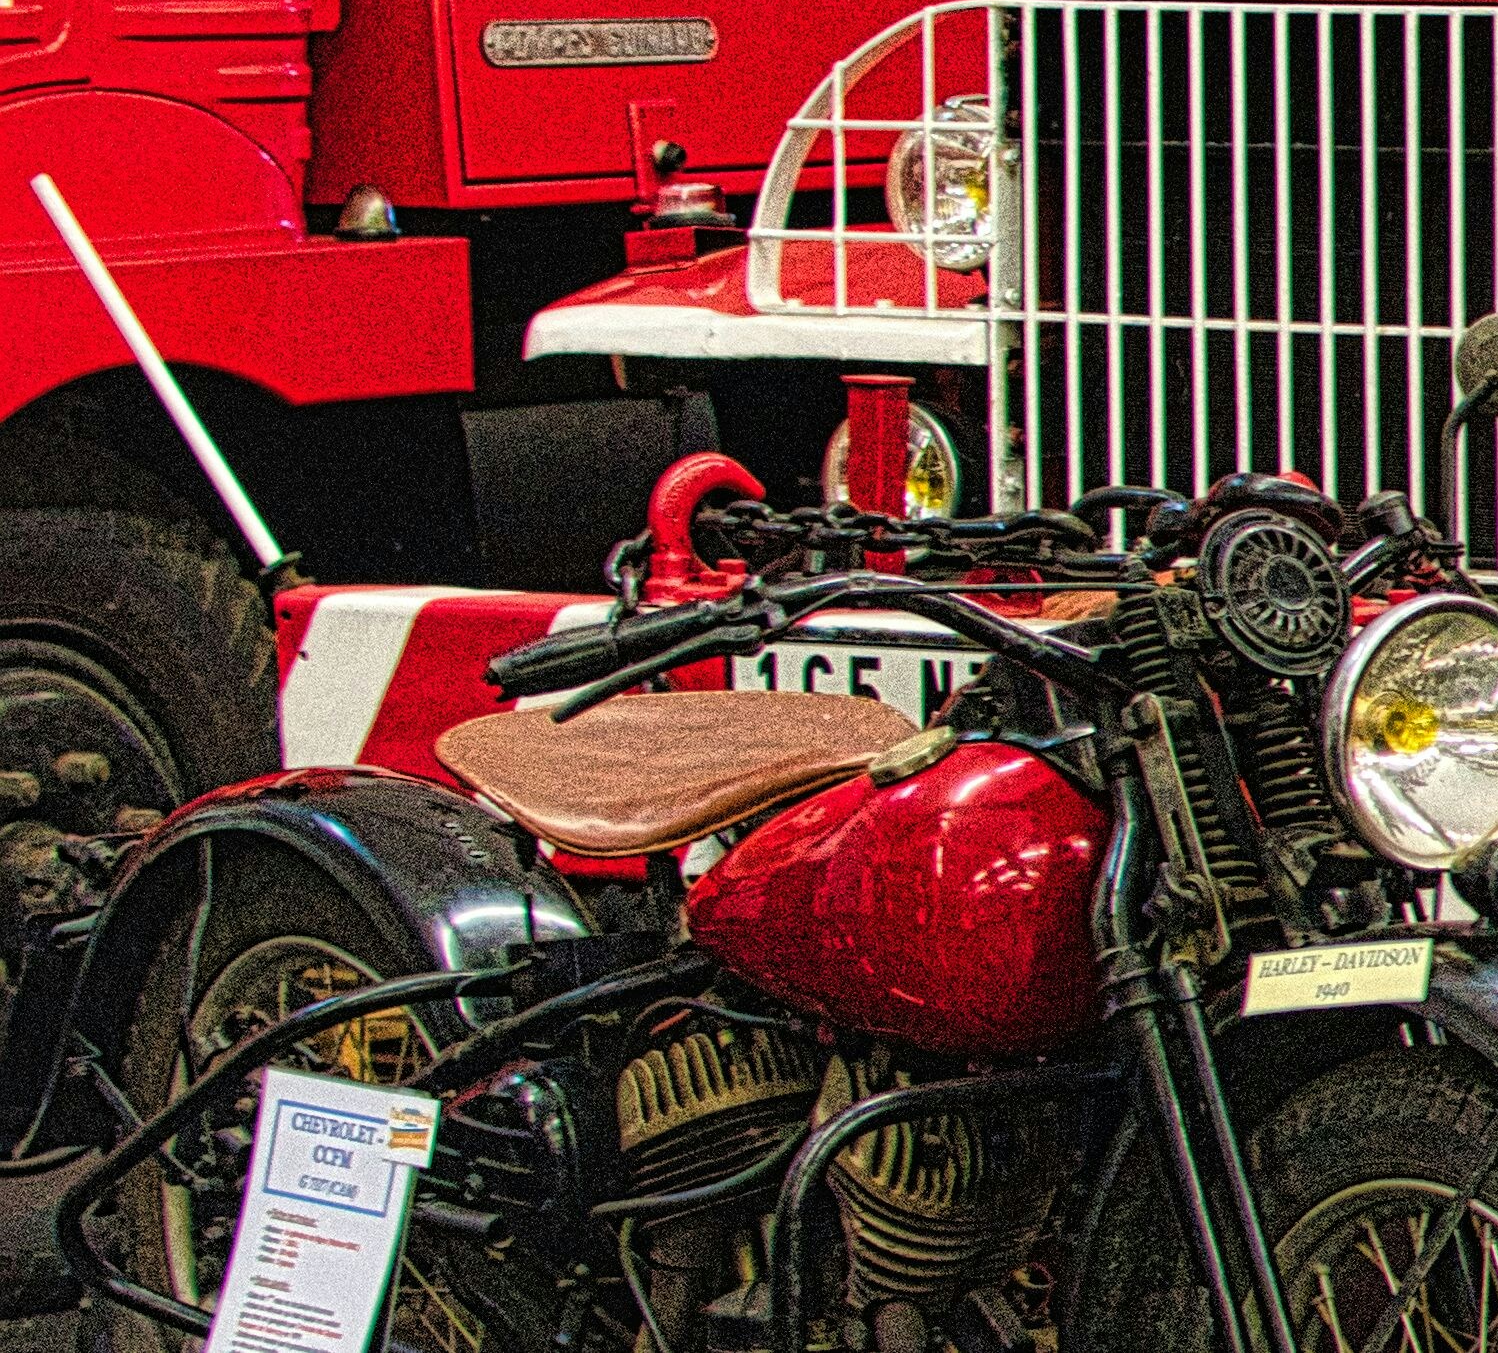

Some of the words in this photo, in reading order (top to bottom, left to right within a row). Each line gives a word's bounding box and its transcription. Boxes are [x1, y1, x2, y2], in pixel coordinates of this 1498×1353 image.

[1257, 954, 1321, 979] HARLEY
[1333, 947, 1423, 971] DAVIDSON
[290, 1112, 378, 1146] CHEVROLET
